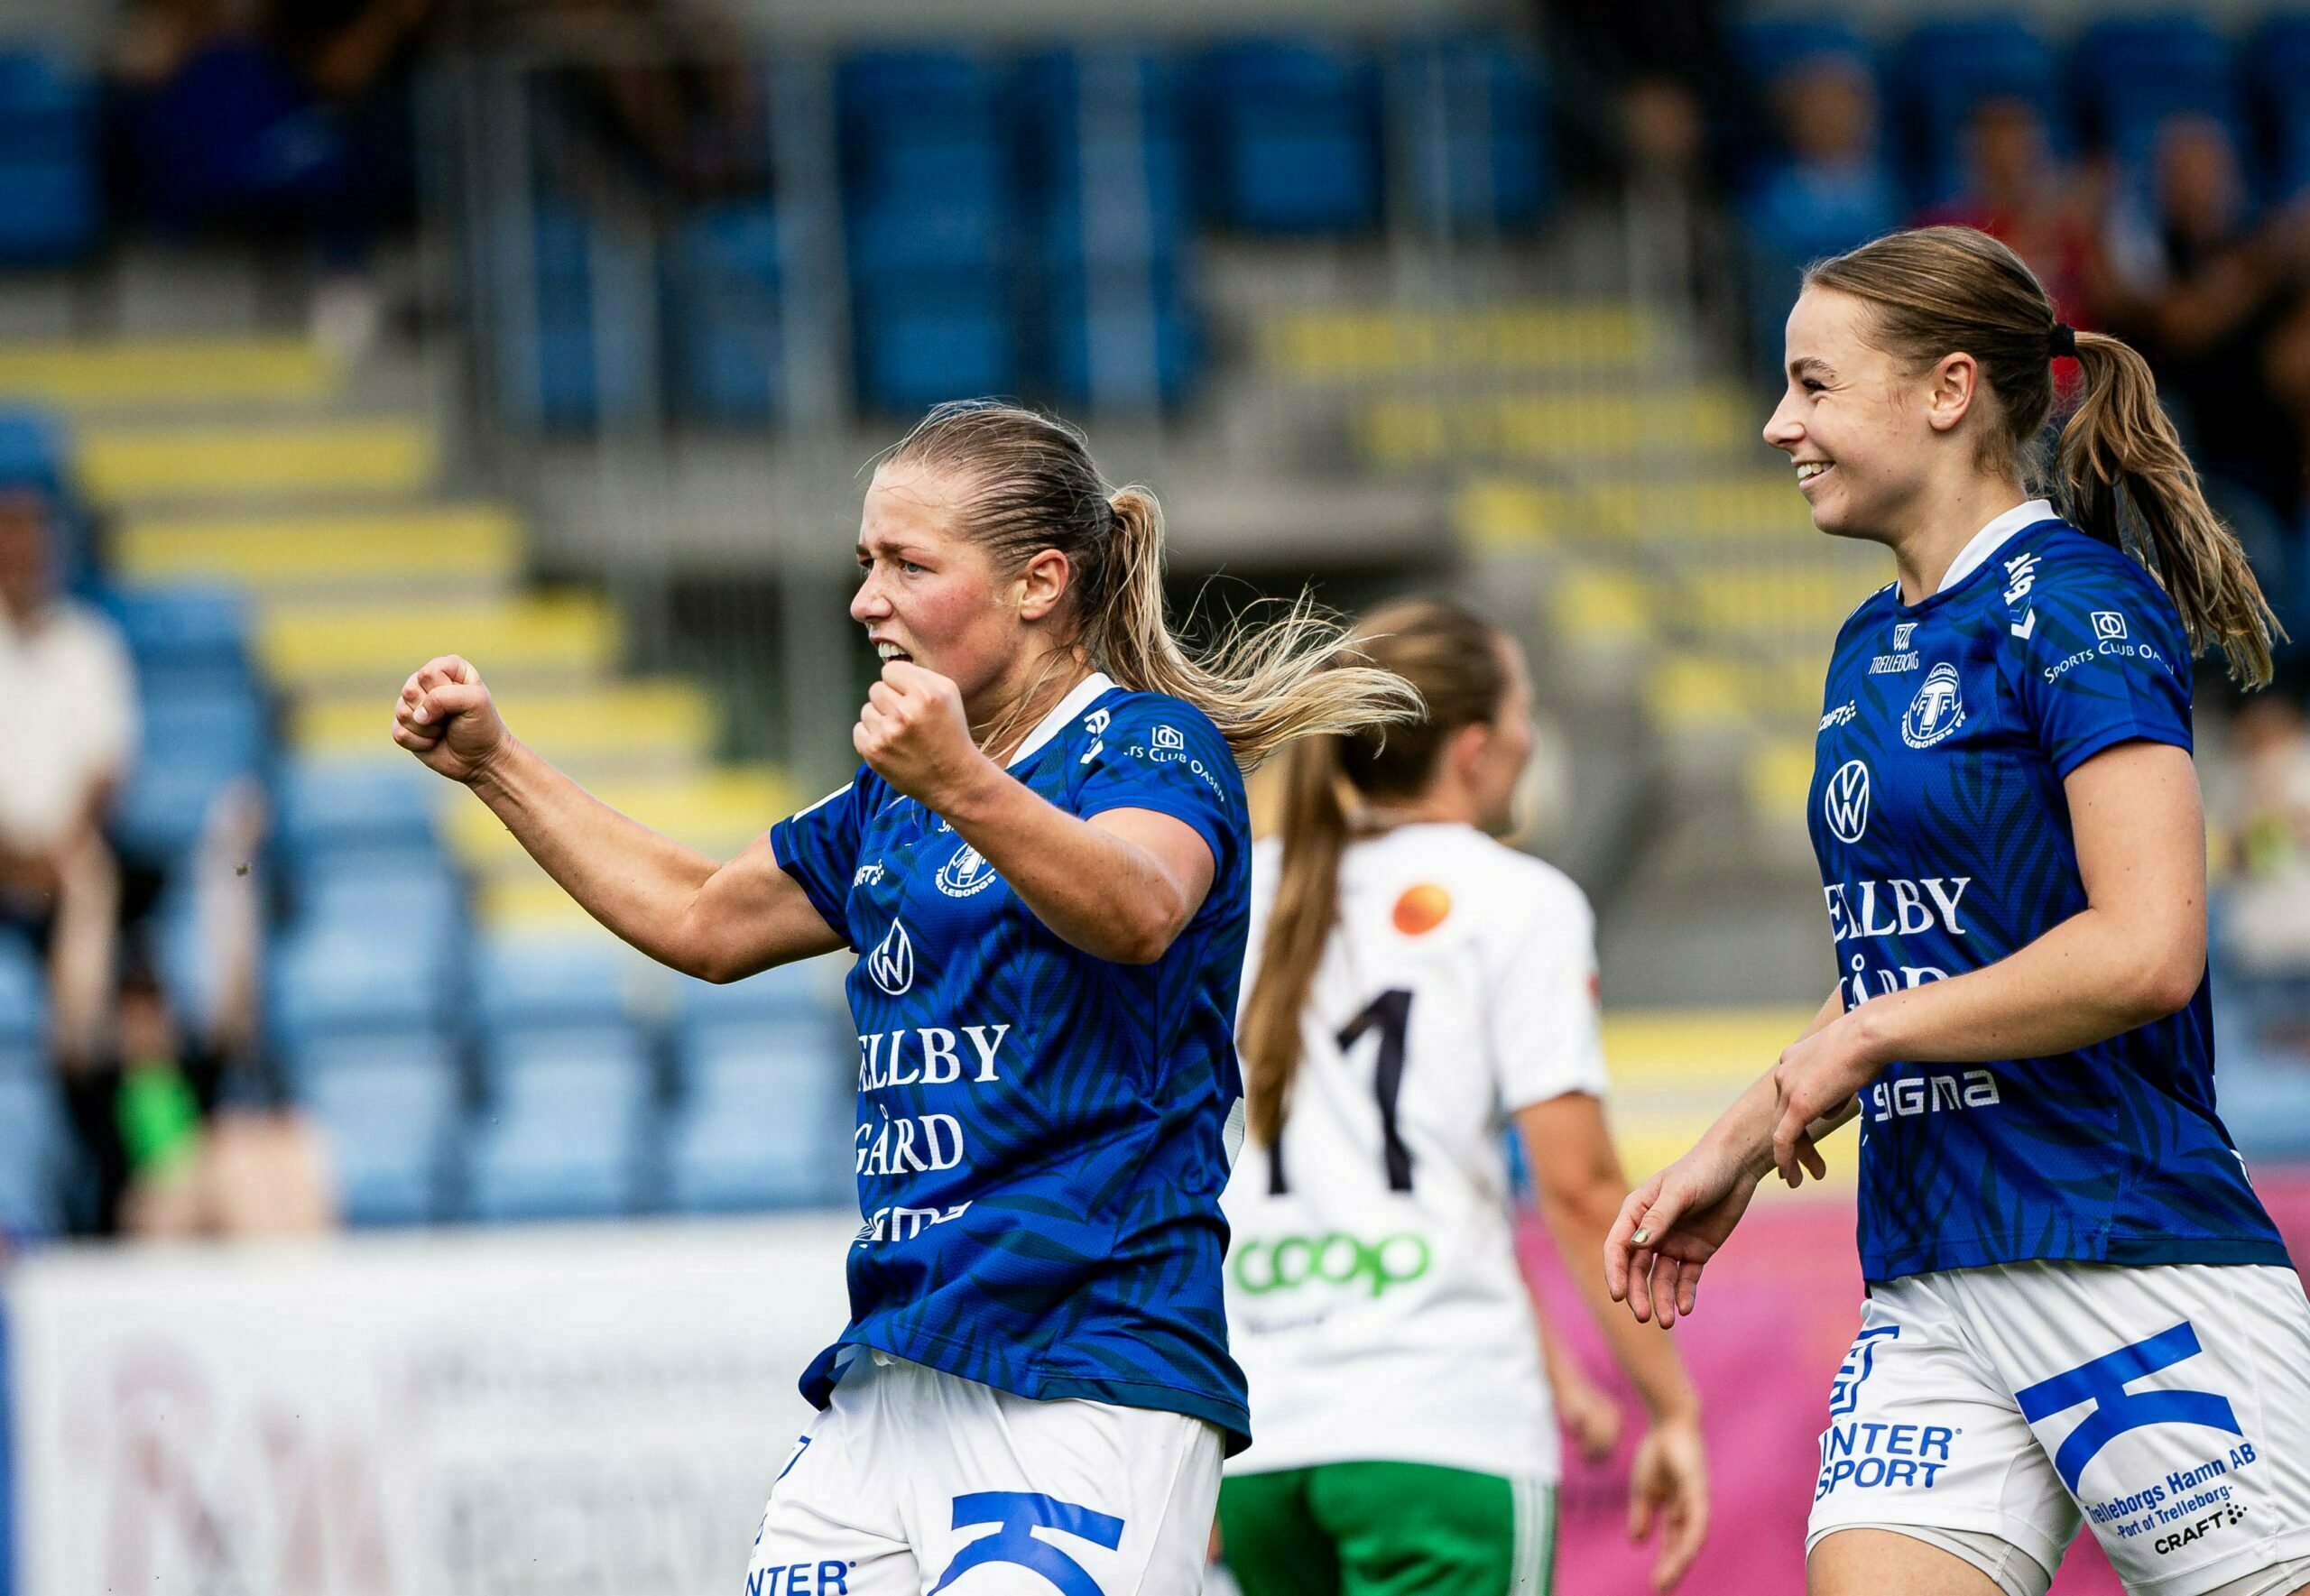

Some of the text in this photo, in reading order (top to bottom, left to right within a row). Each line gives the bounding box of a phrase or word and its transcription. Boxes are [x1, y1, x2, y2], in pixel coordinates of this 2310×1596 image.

[1869, 650, 1918, 675] TRELLEBORG
[2044, 649, 2094, 684] SPORTS
[2098, 641, 2135, 657] CLUB
[1149, 748, 1187, 763] CLUB
[1824, 877, 1972, 944] ELLBY
[1234, 1232, 1430, 1298] coop
[1816, 1458, 1947, 1502] SPORT
[2085, 1443, 2257, 1524] Trelleborgs Hamn AB
[2142, 1514, 2156, 1531] of
[2155, 1510, 2223, 1555] CRAFT
[745, 1560, 848, 1596] NTER
